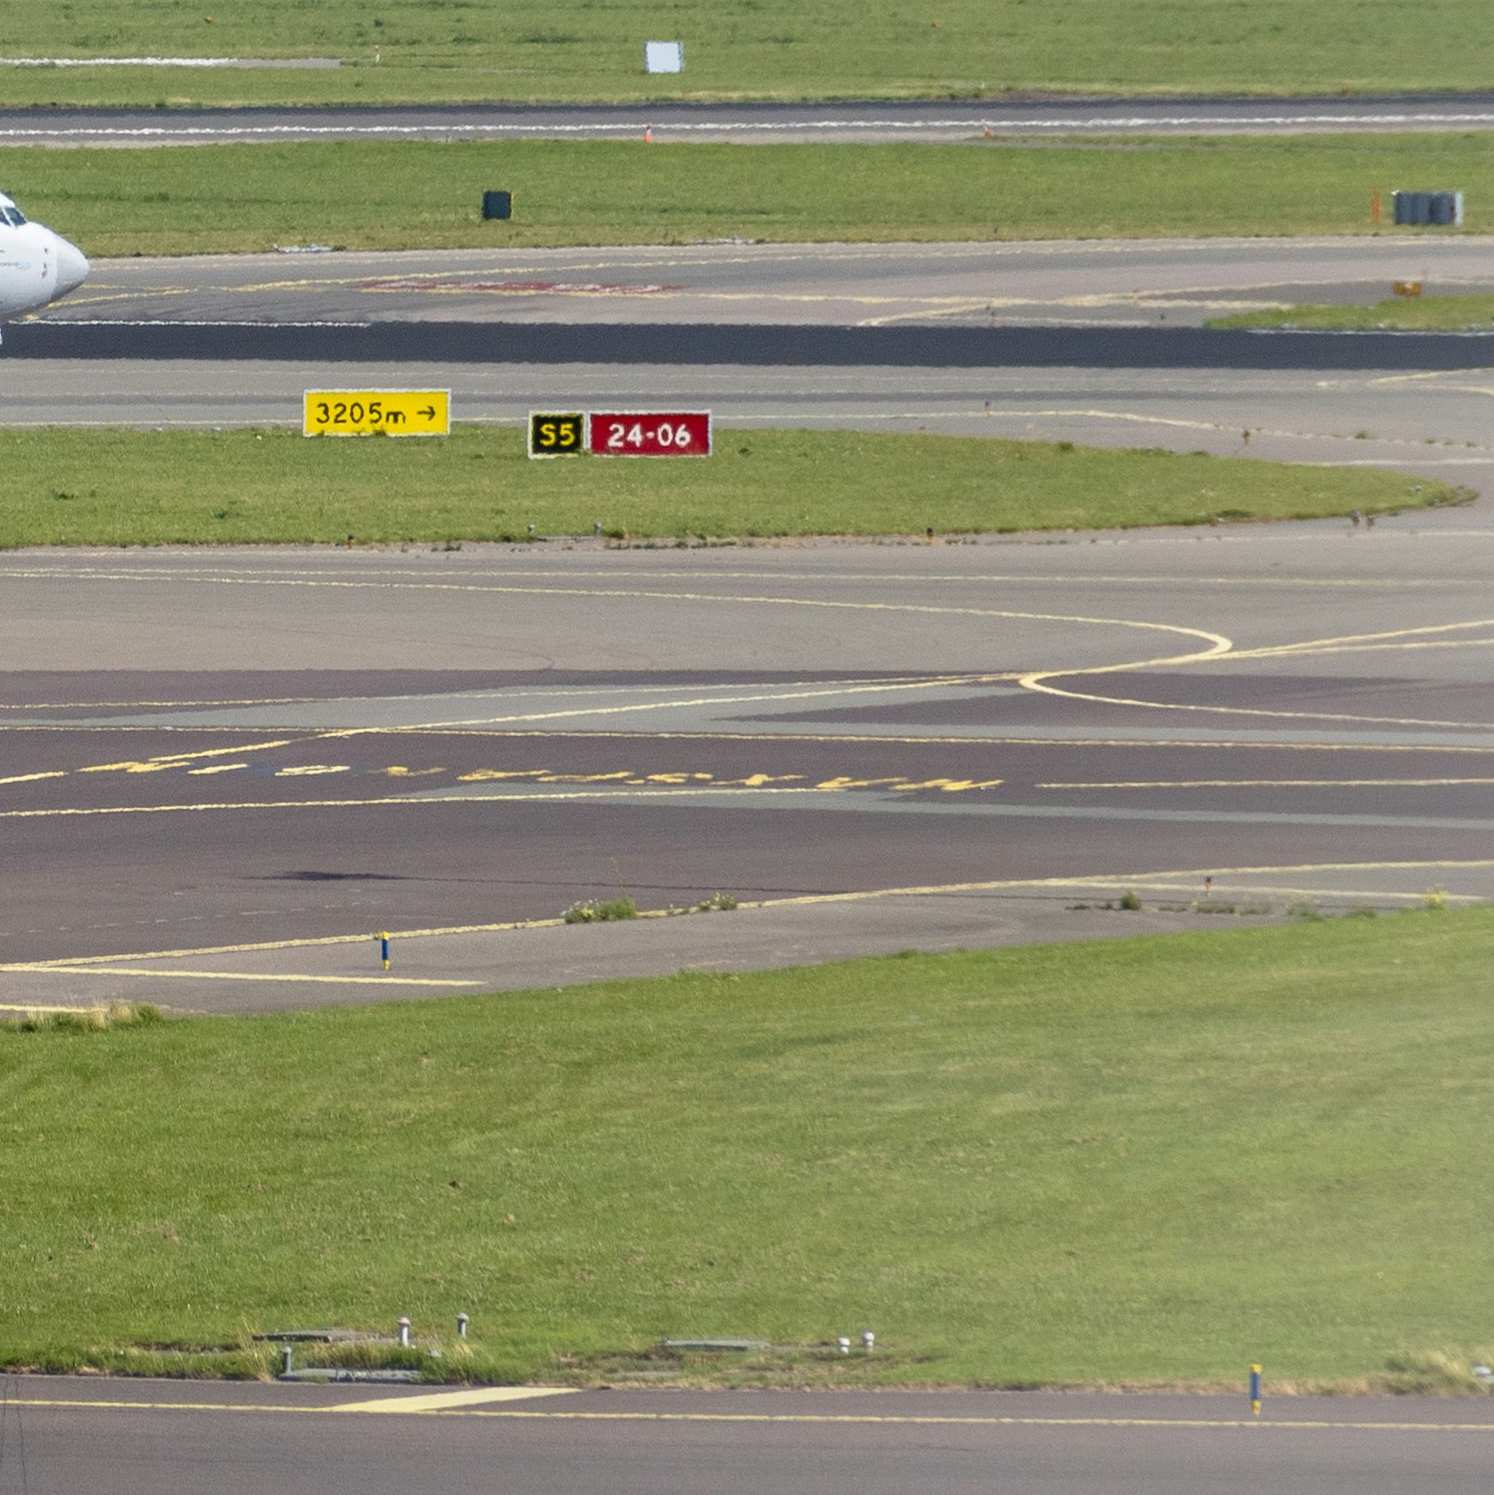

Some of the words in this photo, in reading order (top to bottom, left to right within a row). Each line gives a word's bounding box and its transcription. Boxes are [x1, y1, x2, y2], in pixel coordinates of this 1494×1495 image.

[316, 402, 406, 424] 3205m
[539, 423, 575, 447] S5
[607, 422, 692, 448] 24-06
